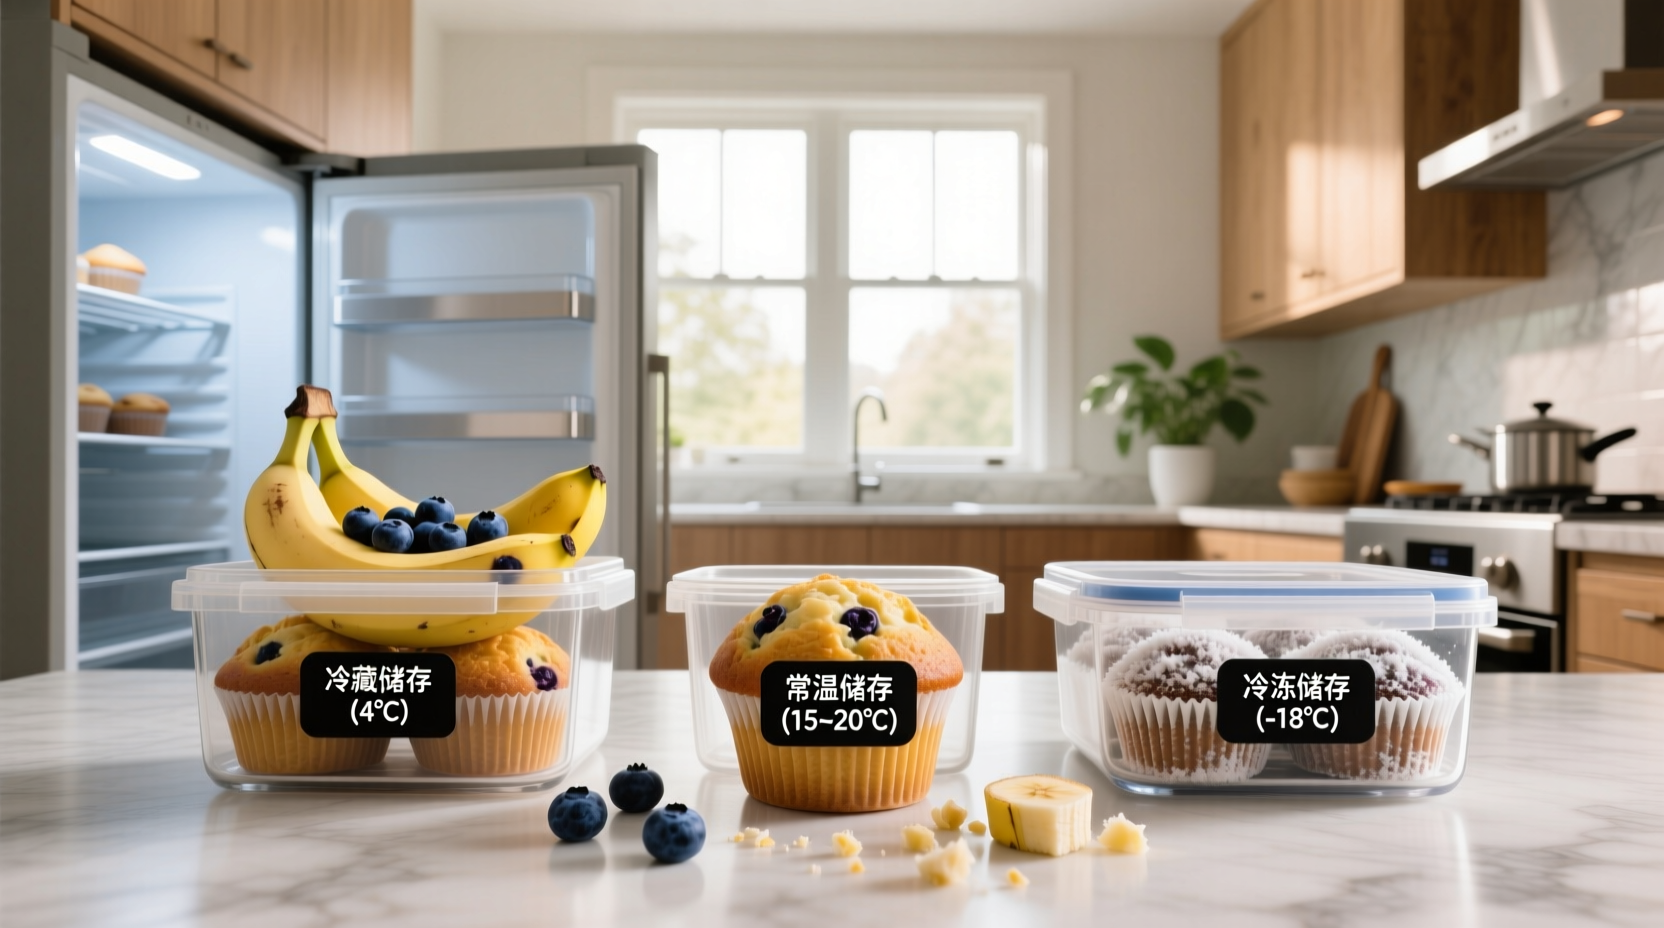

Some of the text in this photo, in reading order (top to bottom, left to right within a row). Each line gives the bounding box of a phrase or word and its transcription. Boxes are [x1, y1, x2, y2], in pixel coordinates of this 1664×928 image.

[325, 664, 431, 693] 冷藏储存
[786, 673, 892, 702] 常温储存
[1244, 671, 1350, 701] 冷冻储存
